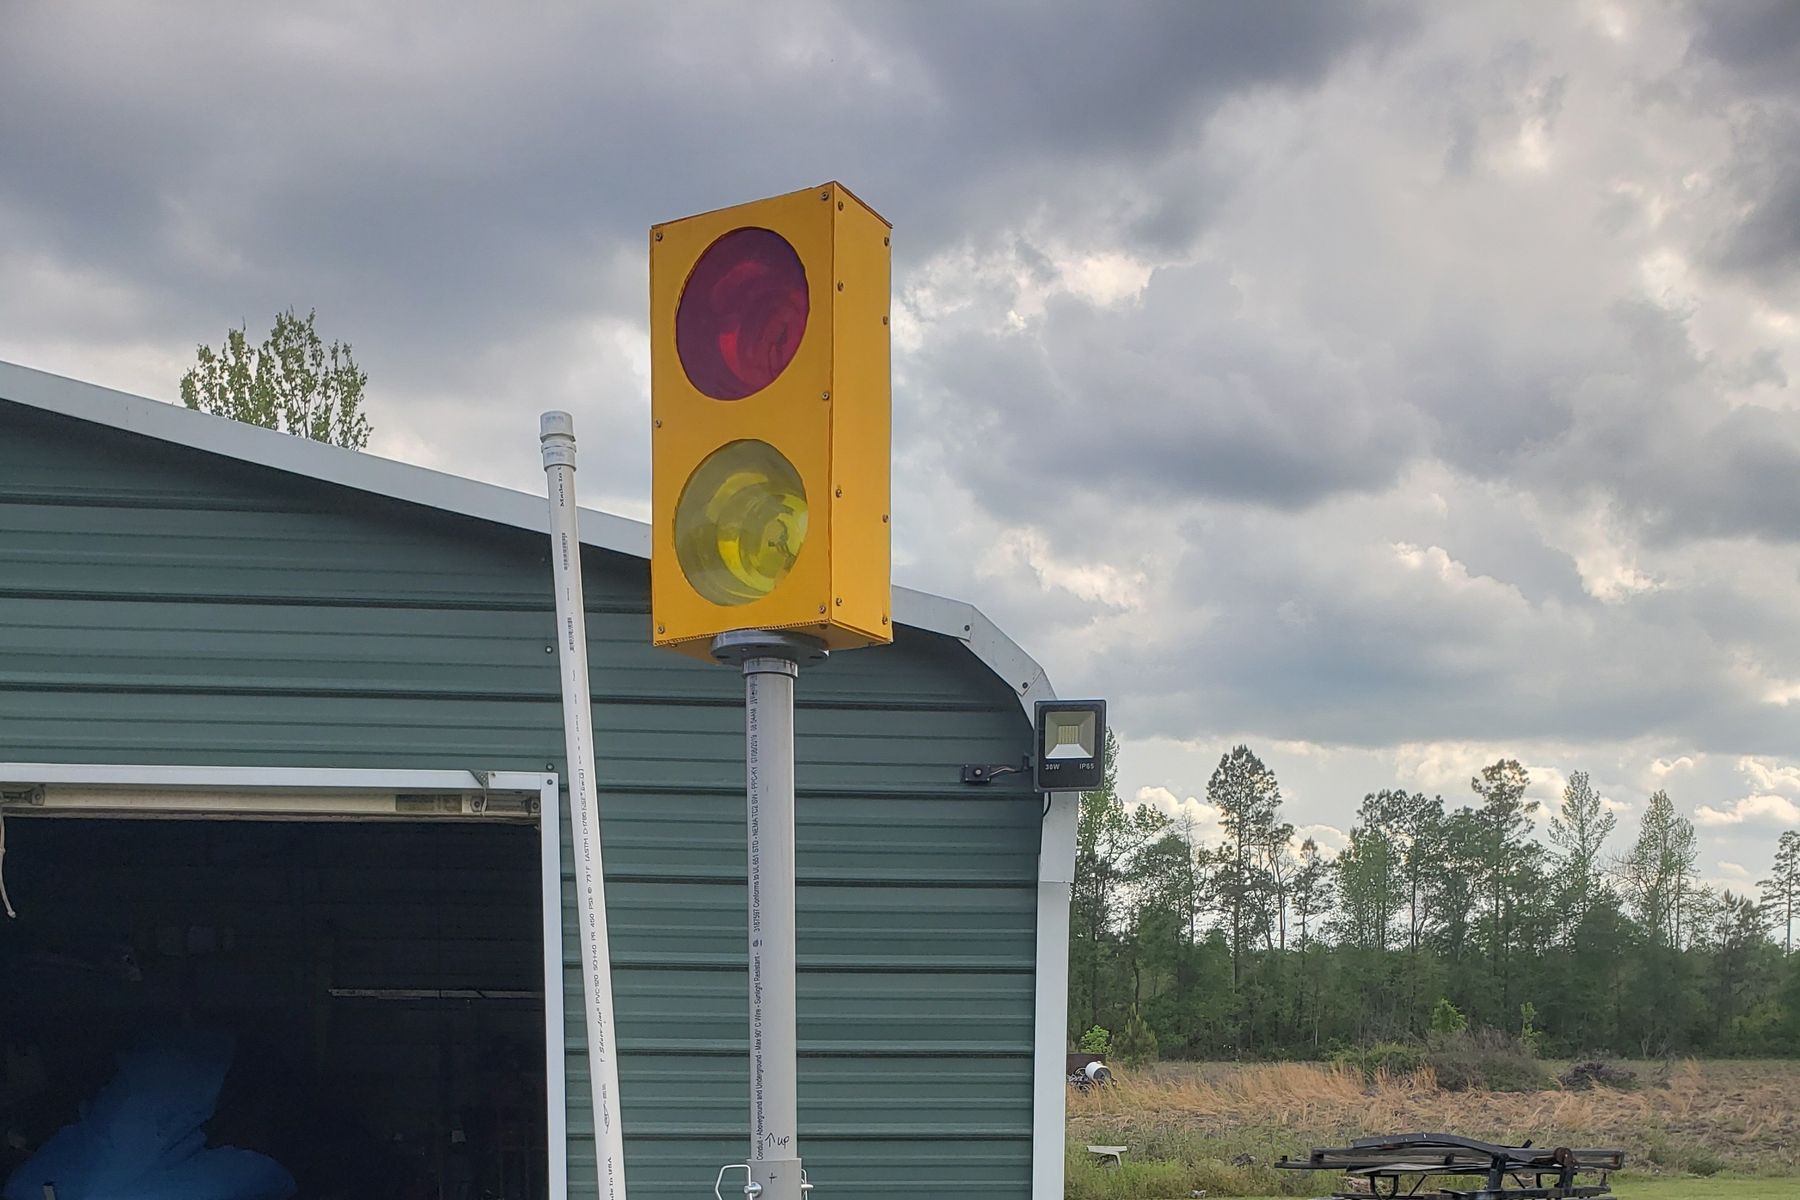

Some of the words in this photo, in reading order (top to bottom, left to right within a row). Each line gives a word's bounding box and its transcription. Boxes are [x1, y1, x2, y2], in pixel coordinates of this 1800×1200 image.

[1079, 762, 1095, 770] IP65
[753, 956, 761, 981] Resistant
[754, 981, 762, 1004] Sunlight
[755, 1055, 764, 1089] Underground
[756, 1101, 764, 1136] Aboveground
[756, 1139, 764, 1161] Conduit
